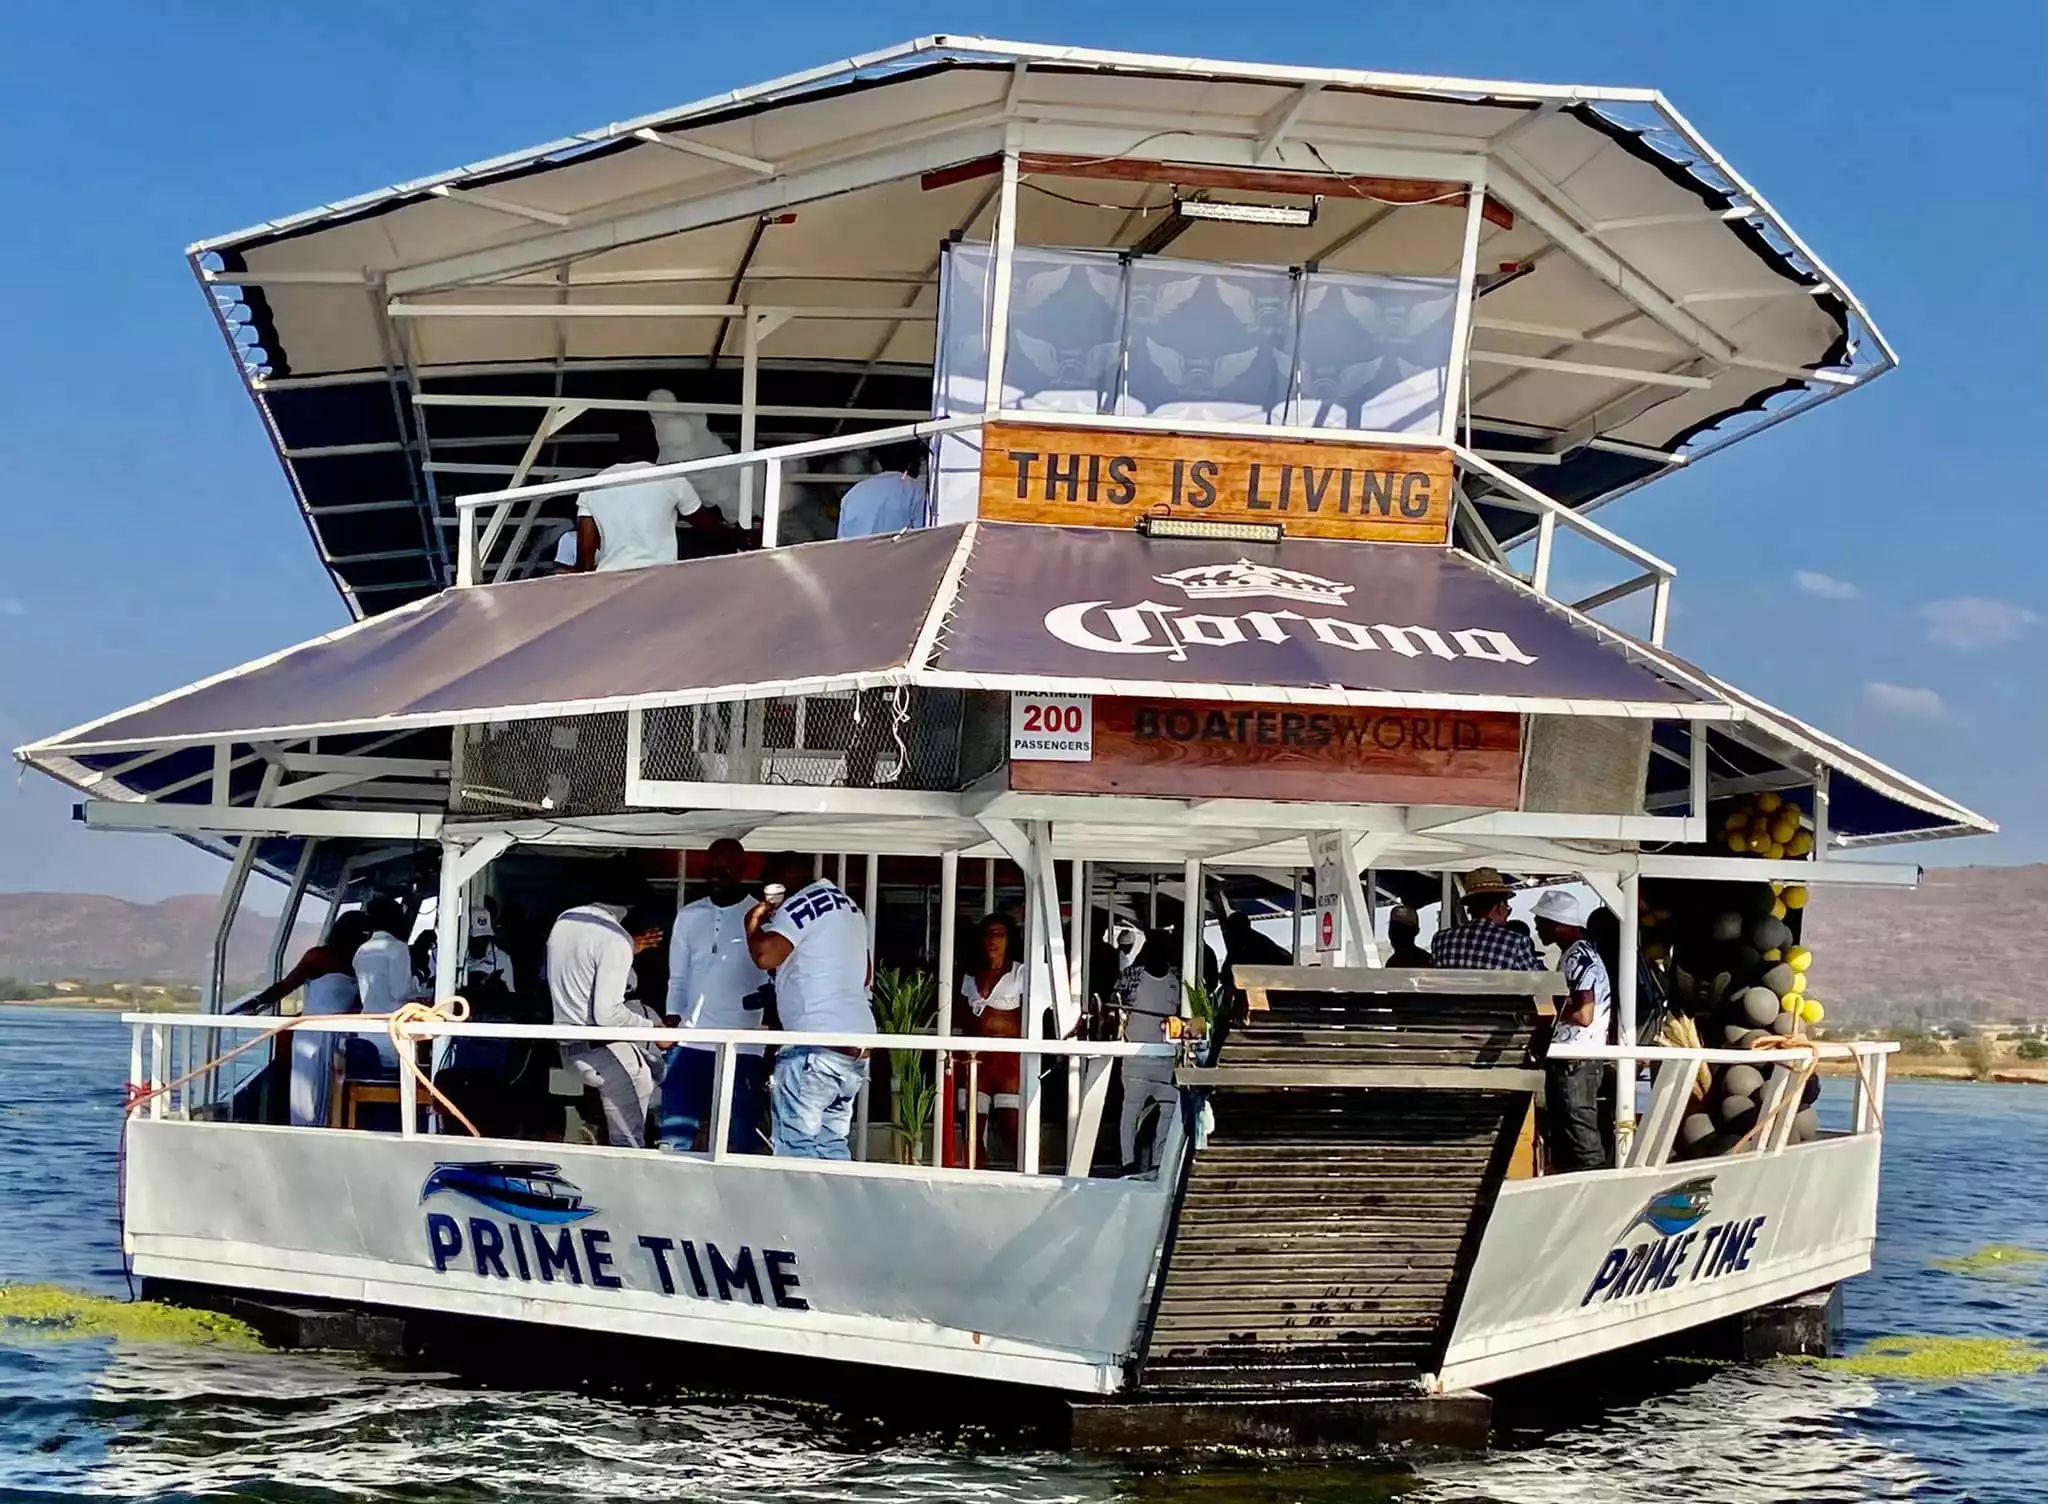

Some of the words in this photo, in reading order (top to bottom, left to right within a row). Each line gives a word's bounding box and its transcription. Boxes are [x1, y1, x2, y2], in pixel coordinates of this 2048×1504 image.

[1009, 451, 1136, 504] THIS
[1170, 459, 1220, 508] IS
[1247, 463, 1431, 519] LIVING
[1044, 599, 1538, 665] Corona
[1014, 739, 1090, 751] PASSENGERS
[1023, 704, 1082, 733] 200
[426, 1212, 622, 1290] PRIME
[638, 1235, 811, 1311] TIME
[1580, 1230, 1699, 1307] PRIME
[1690, 1215, 1767, 1282] TIME
